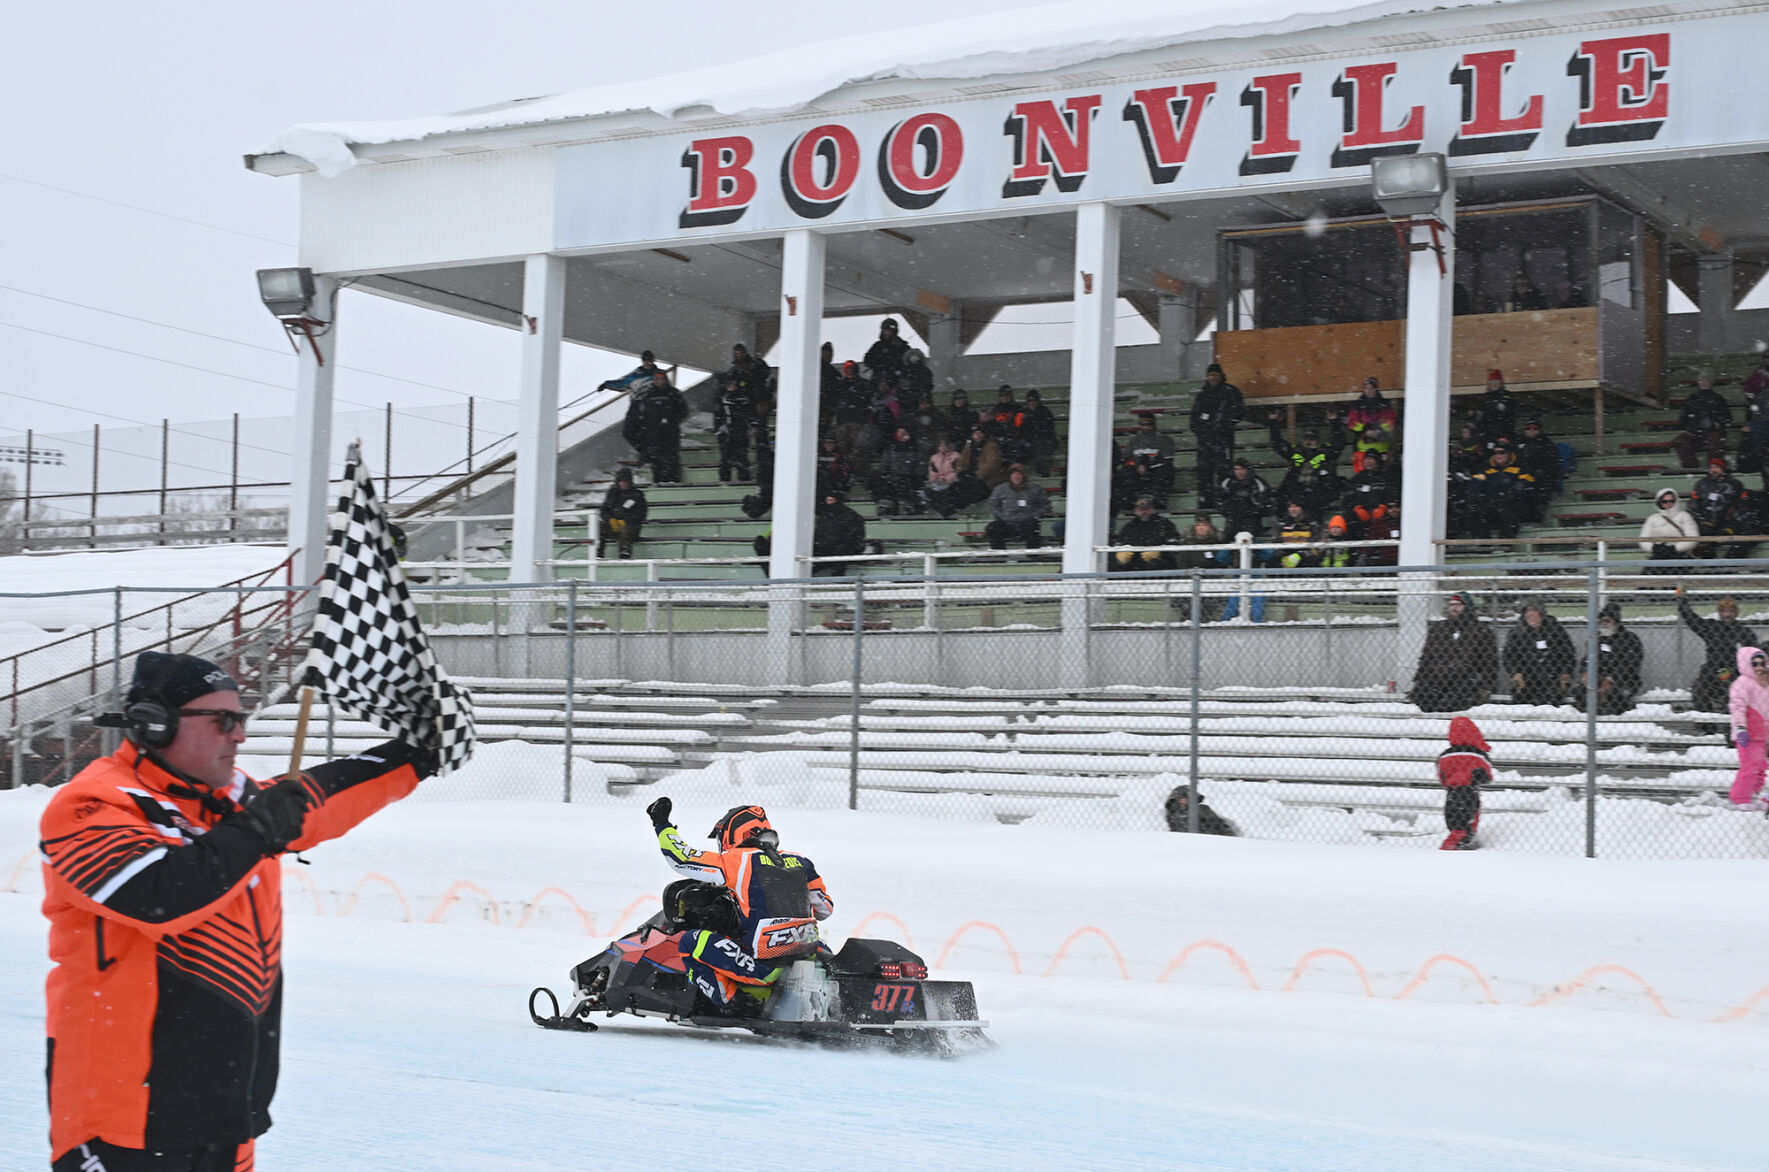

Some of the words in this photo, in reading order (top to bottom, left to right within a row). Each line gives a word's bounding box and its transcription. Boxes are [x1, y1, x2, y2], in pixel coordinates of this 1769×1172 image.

[680, 32, 1670, 229] BOONVILLE
[763, 922, 818, 948] FXR
[713, 938, 756, 973] FXR
